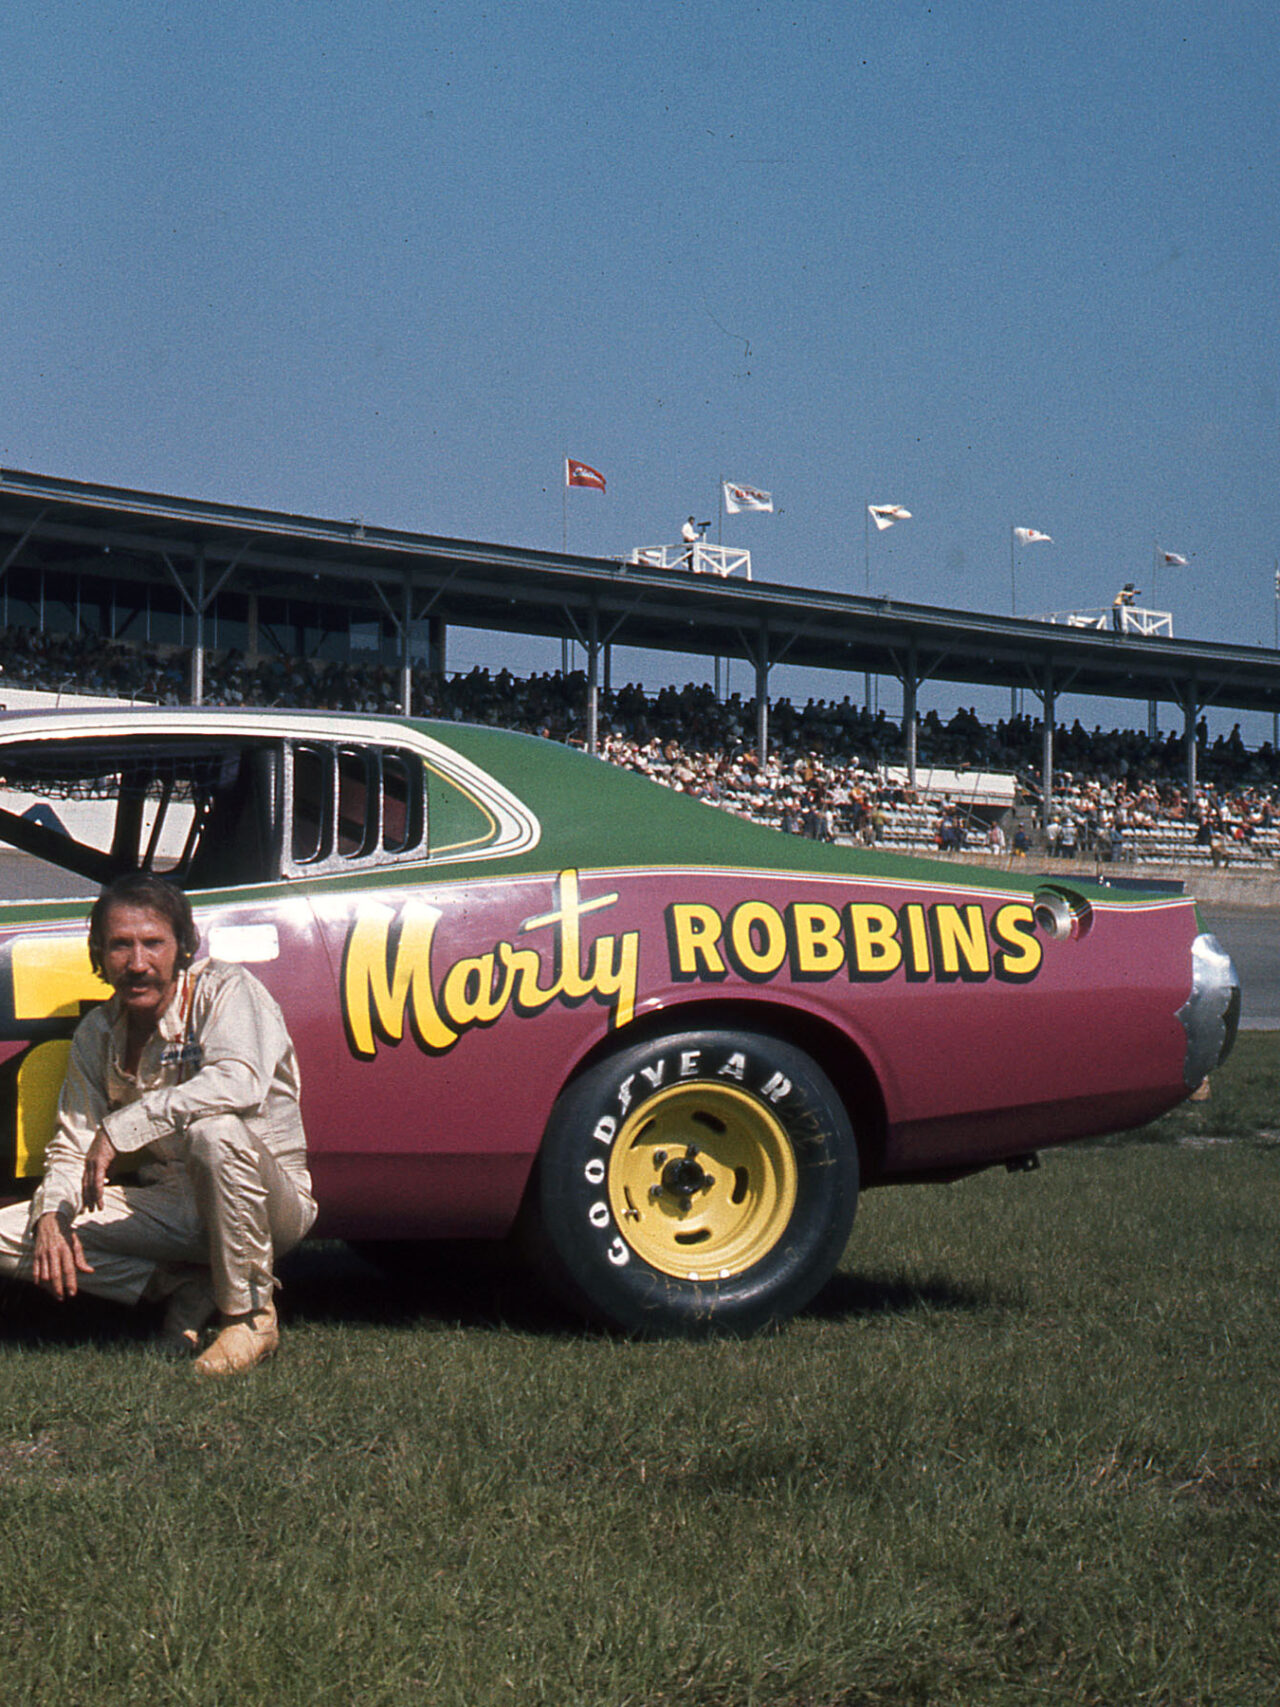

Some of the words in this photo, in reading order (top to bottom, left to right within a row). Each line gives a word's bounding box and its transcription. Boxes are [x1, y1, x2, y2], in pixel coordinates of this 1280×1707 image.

[342, 868, 641, 1056] Marty
[666, 902, 1044, 981] ROBBINS
[584, 1050, 793, 1267] GOODYEAR
